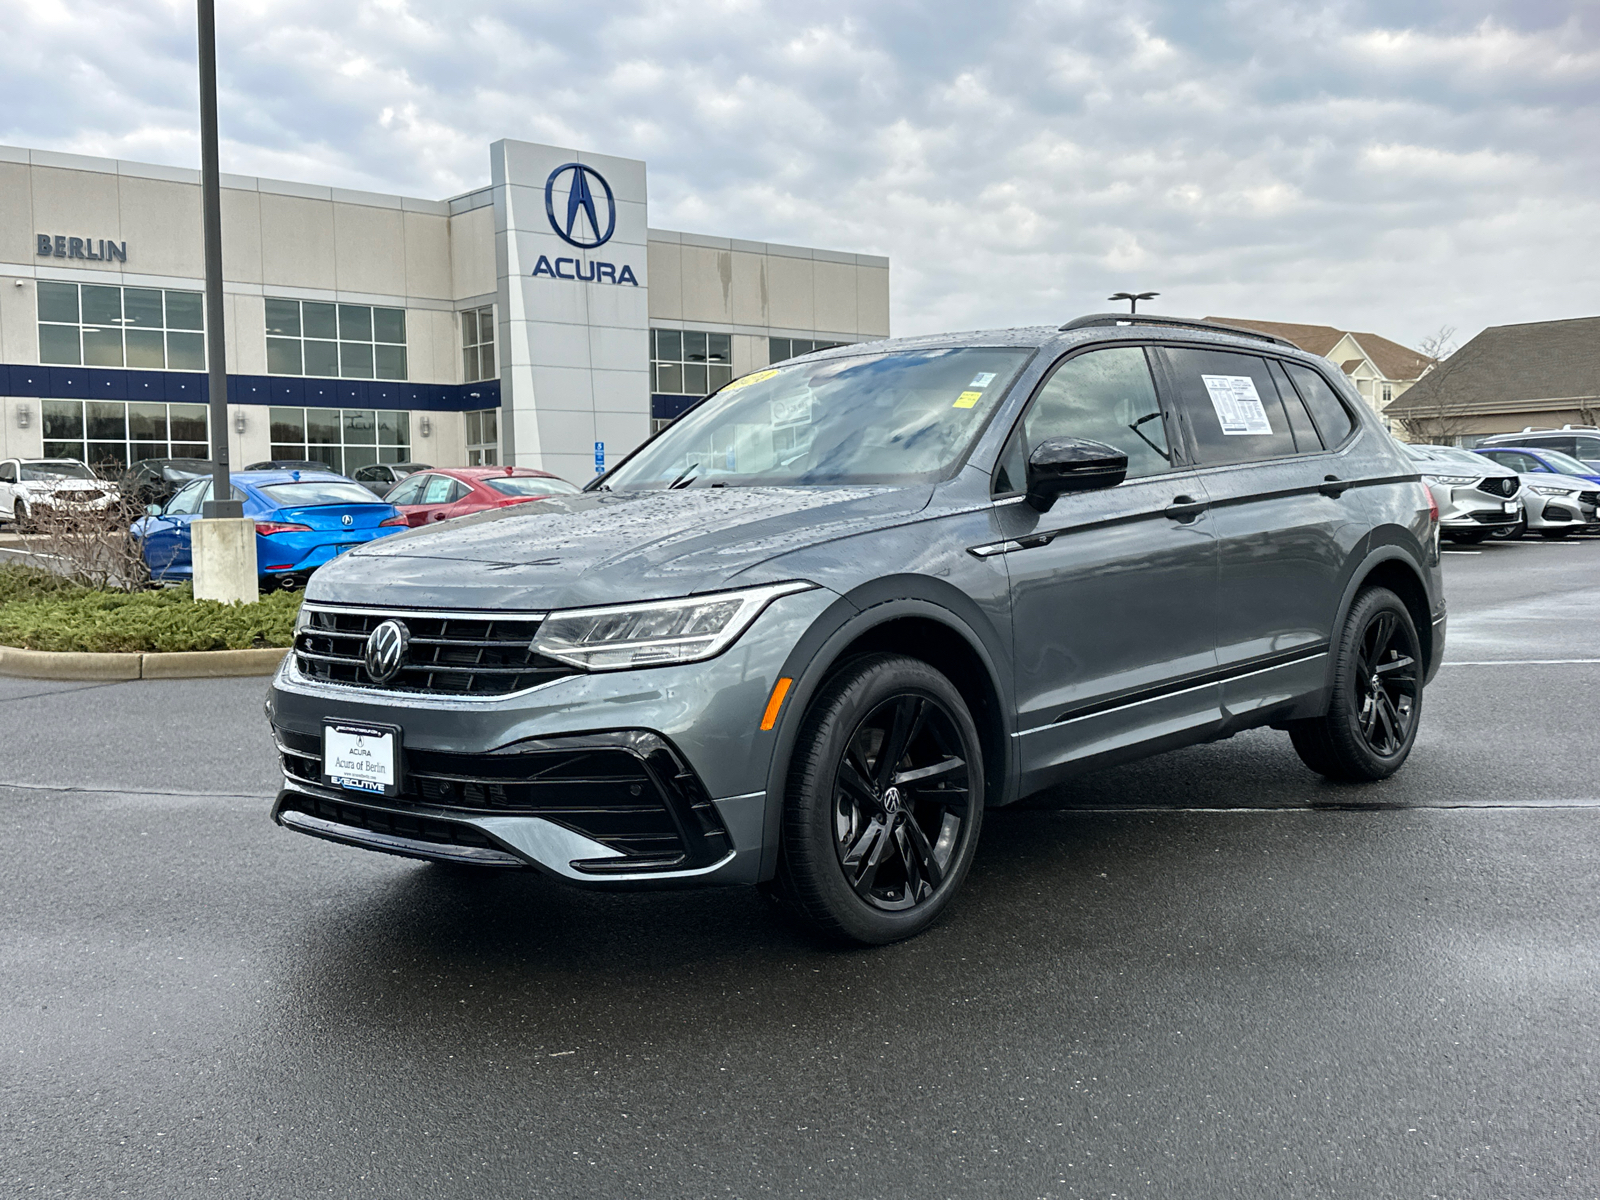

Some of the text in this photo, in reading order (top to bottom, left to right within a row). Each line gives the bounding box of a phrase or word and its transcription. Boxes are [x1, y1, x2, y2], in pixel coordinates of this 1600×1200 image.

[37, 233, 127, 262] BERLIN
[532, 254, 639, 287] ACURA
[349, 748, 372, 757] ACURA
[335, 756, 386, 775] Acura of Berlin
[331, 776, 385, 793] EXECUTIVE
